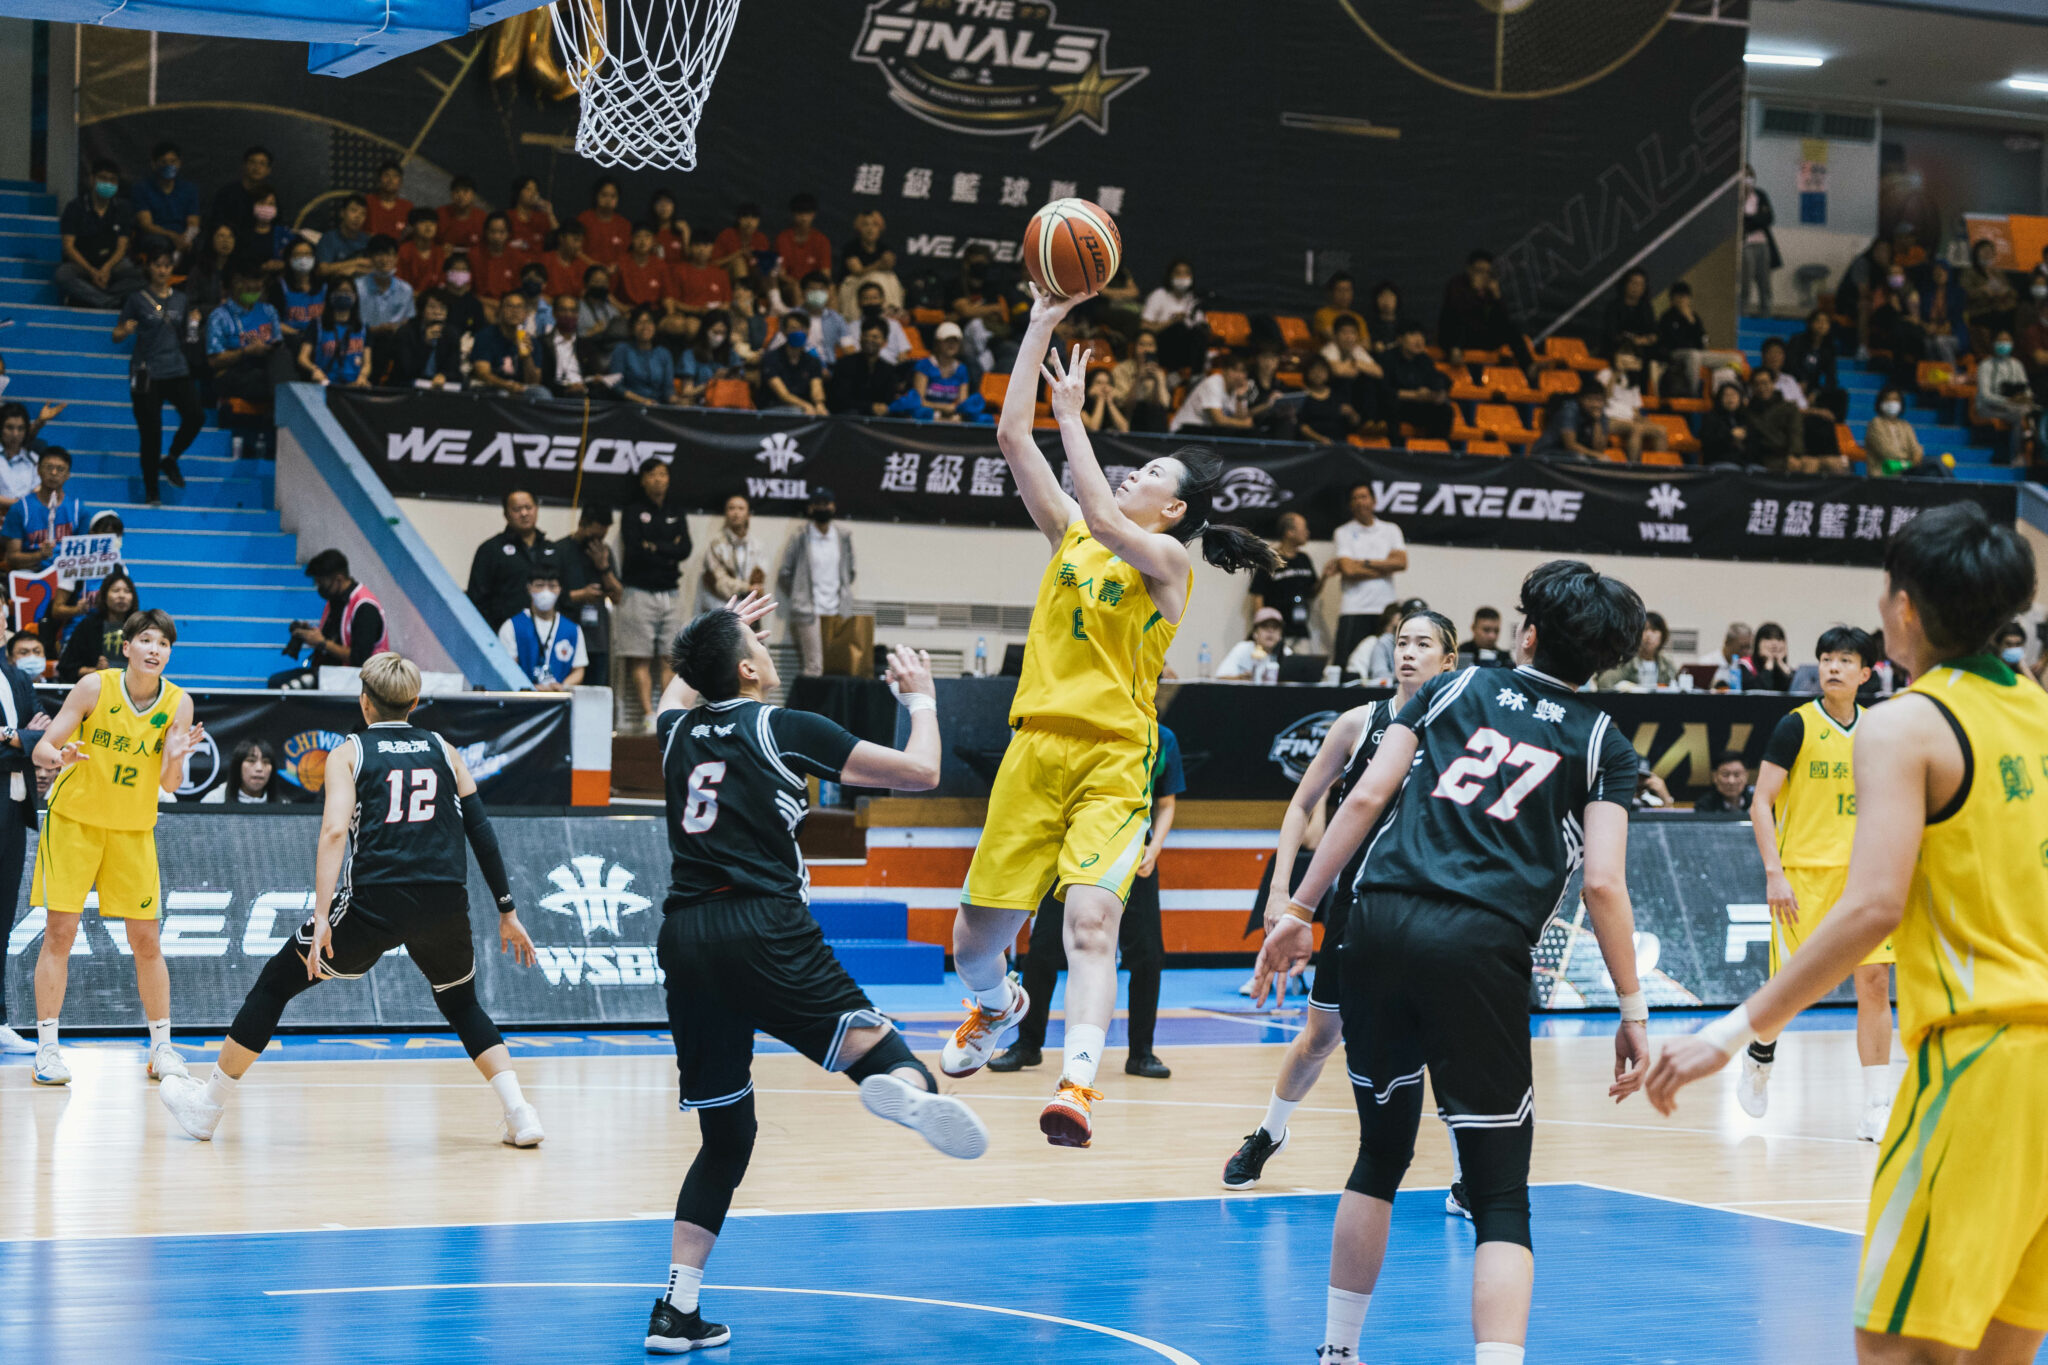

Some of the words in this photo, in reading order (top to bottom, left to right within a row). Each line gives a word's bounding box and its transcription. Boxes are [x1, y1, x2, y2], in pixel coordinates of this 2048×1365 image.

[864, 15, 1098, 74] FINALS
[906, 234, 955, 258] WE
[387, 426, 473, 464] WE
[471, 431, 582, 470] ARE
[1421, 483, 1509, 518] ARE
[1507, 487, 1585, 522] ONE
[57, 558, 77, 569] GO
[78, 555, 98, 566] GO
[99, 551, 119, 562] GO
[1054, 562, 1125, 607] 泰人壽
[112, 763, 138, 788] 12
[384, 767, 438, 824] 12
[1431, 726, 1563, 821] 27
[681, 760, 727, 835] 6
[534, 946, 667, 986] WSB
